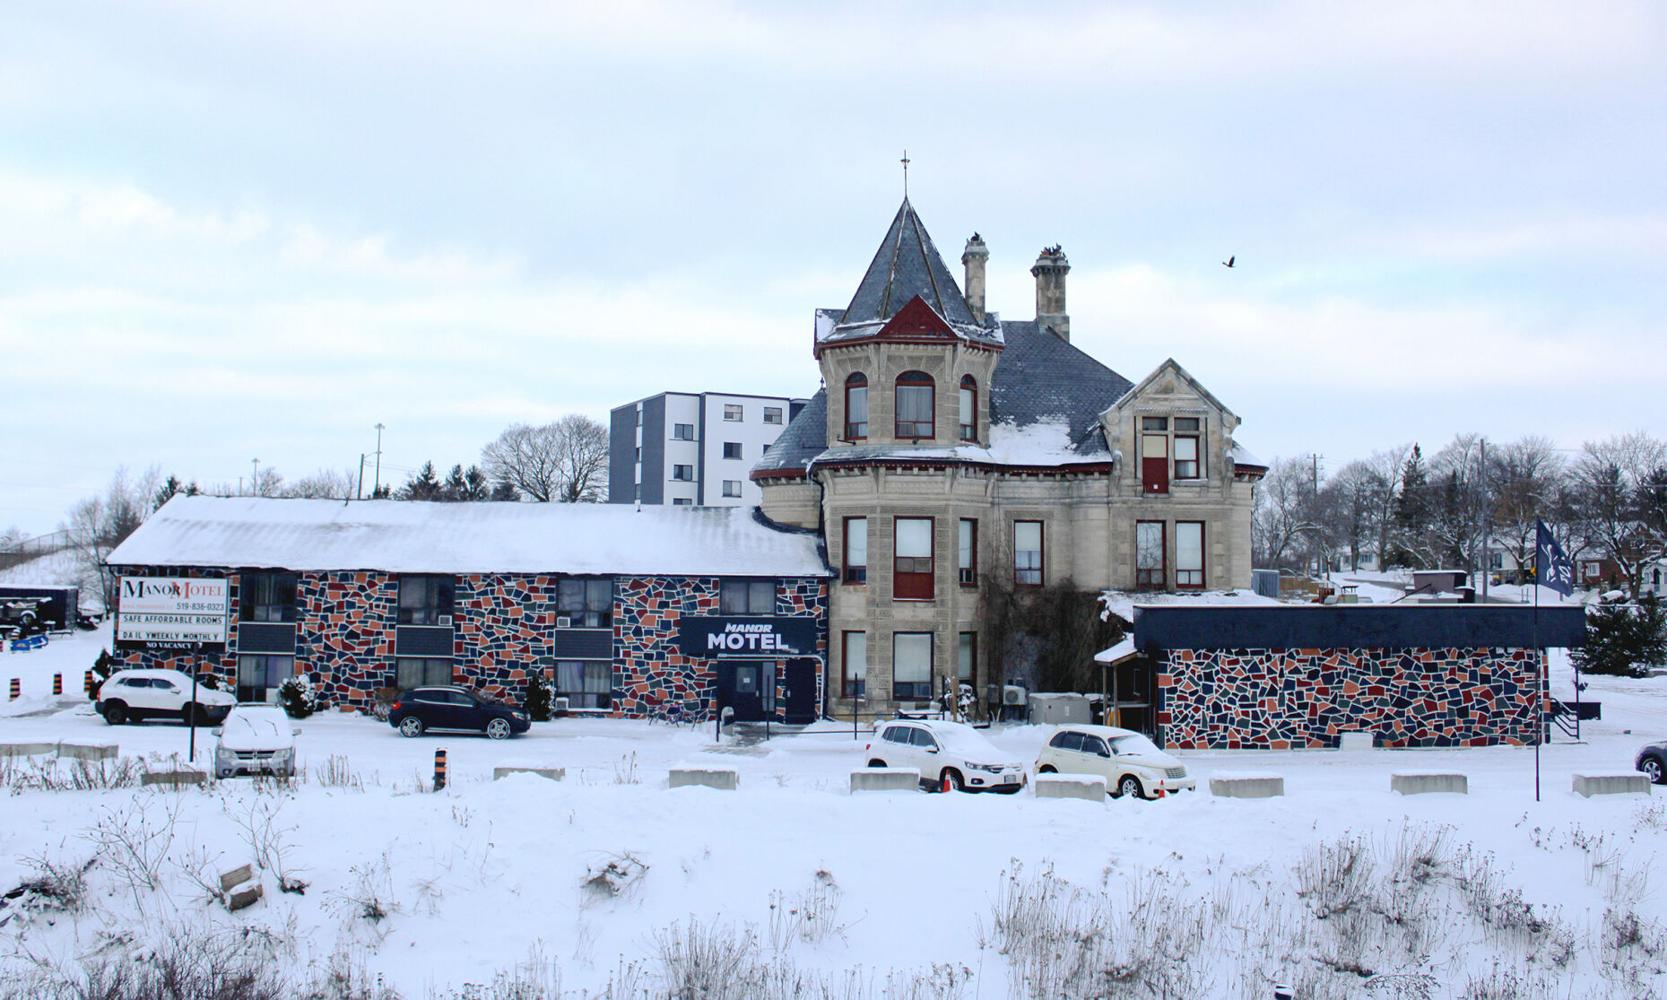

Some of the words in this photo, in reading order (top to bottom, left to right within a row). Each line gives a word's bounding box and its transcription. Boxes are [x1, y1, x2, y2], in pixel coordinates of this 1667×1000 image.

[124, 581, 181, 598] MANOR
[123, 615, 141, 623] SAFE
[145, 615, 192, 624] AFFORDABLE
[725, 623, 772, 633] MANOR
[708, 633, 789, 649] MOTEL
